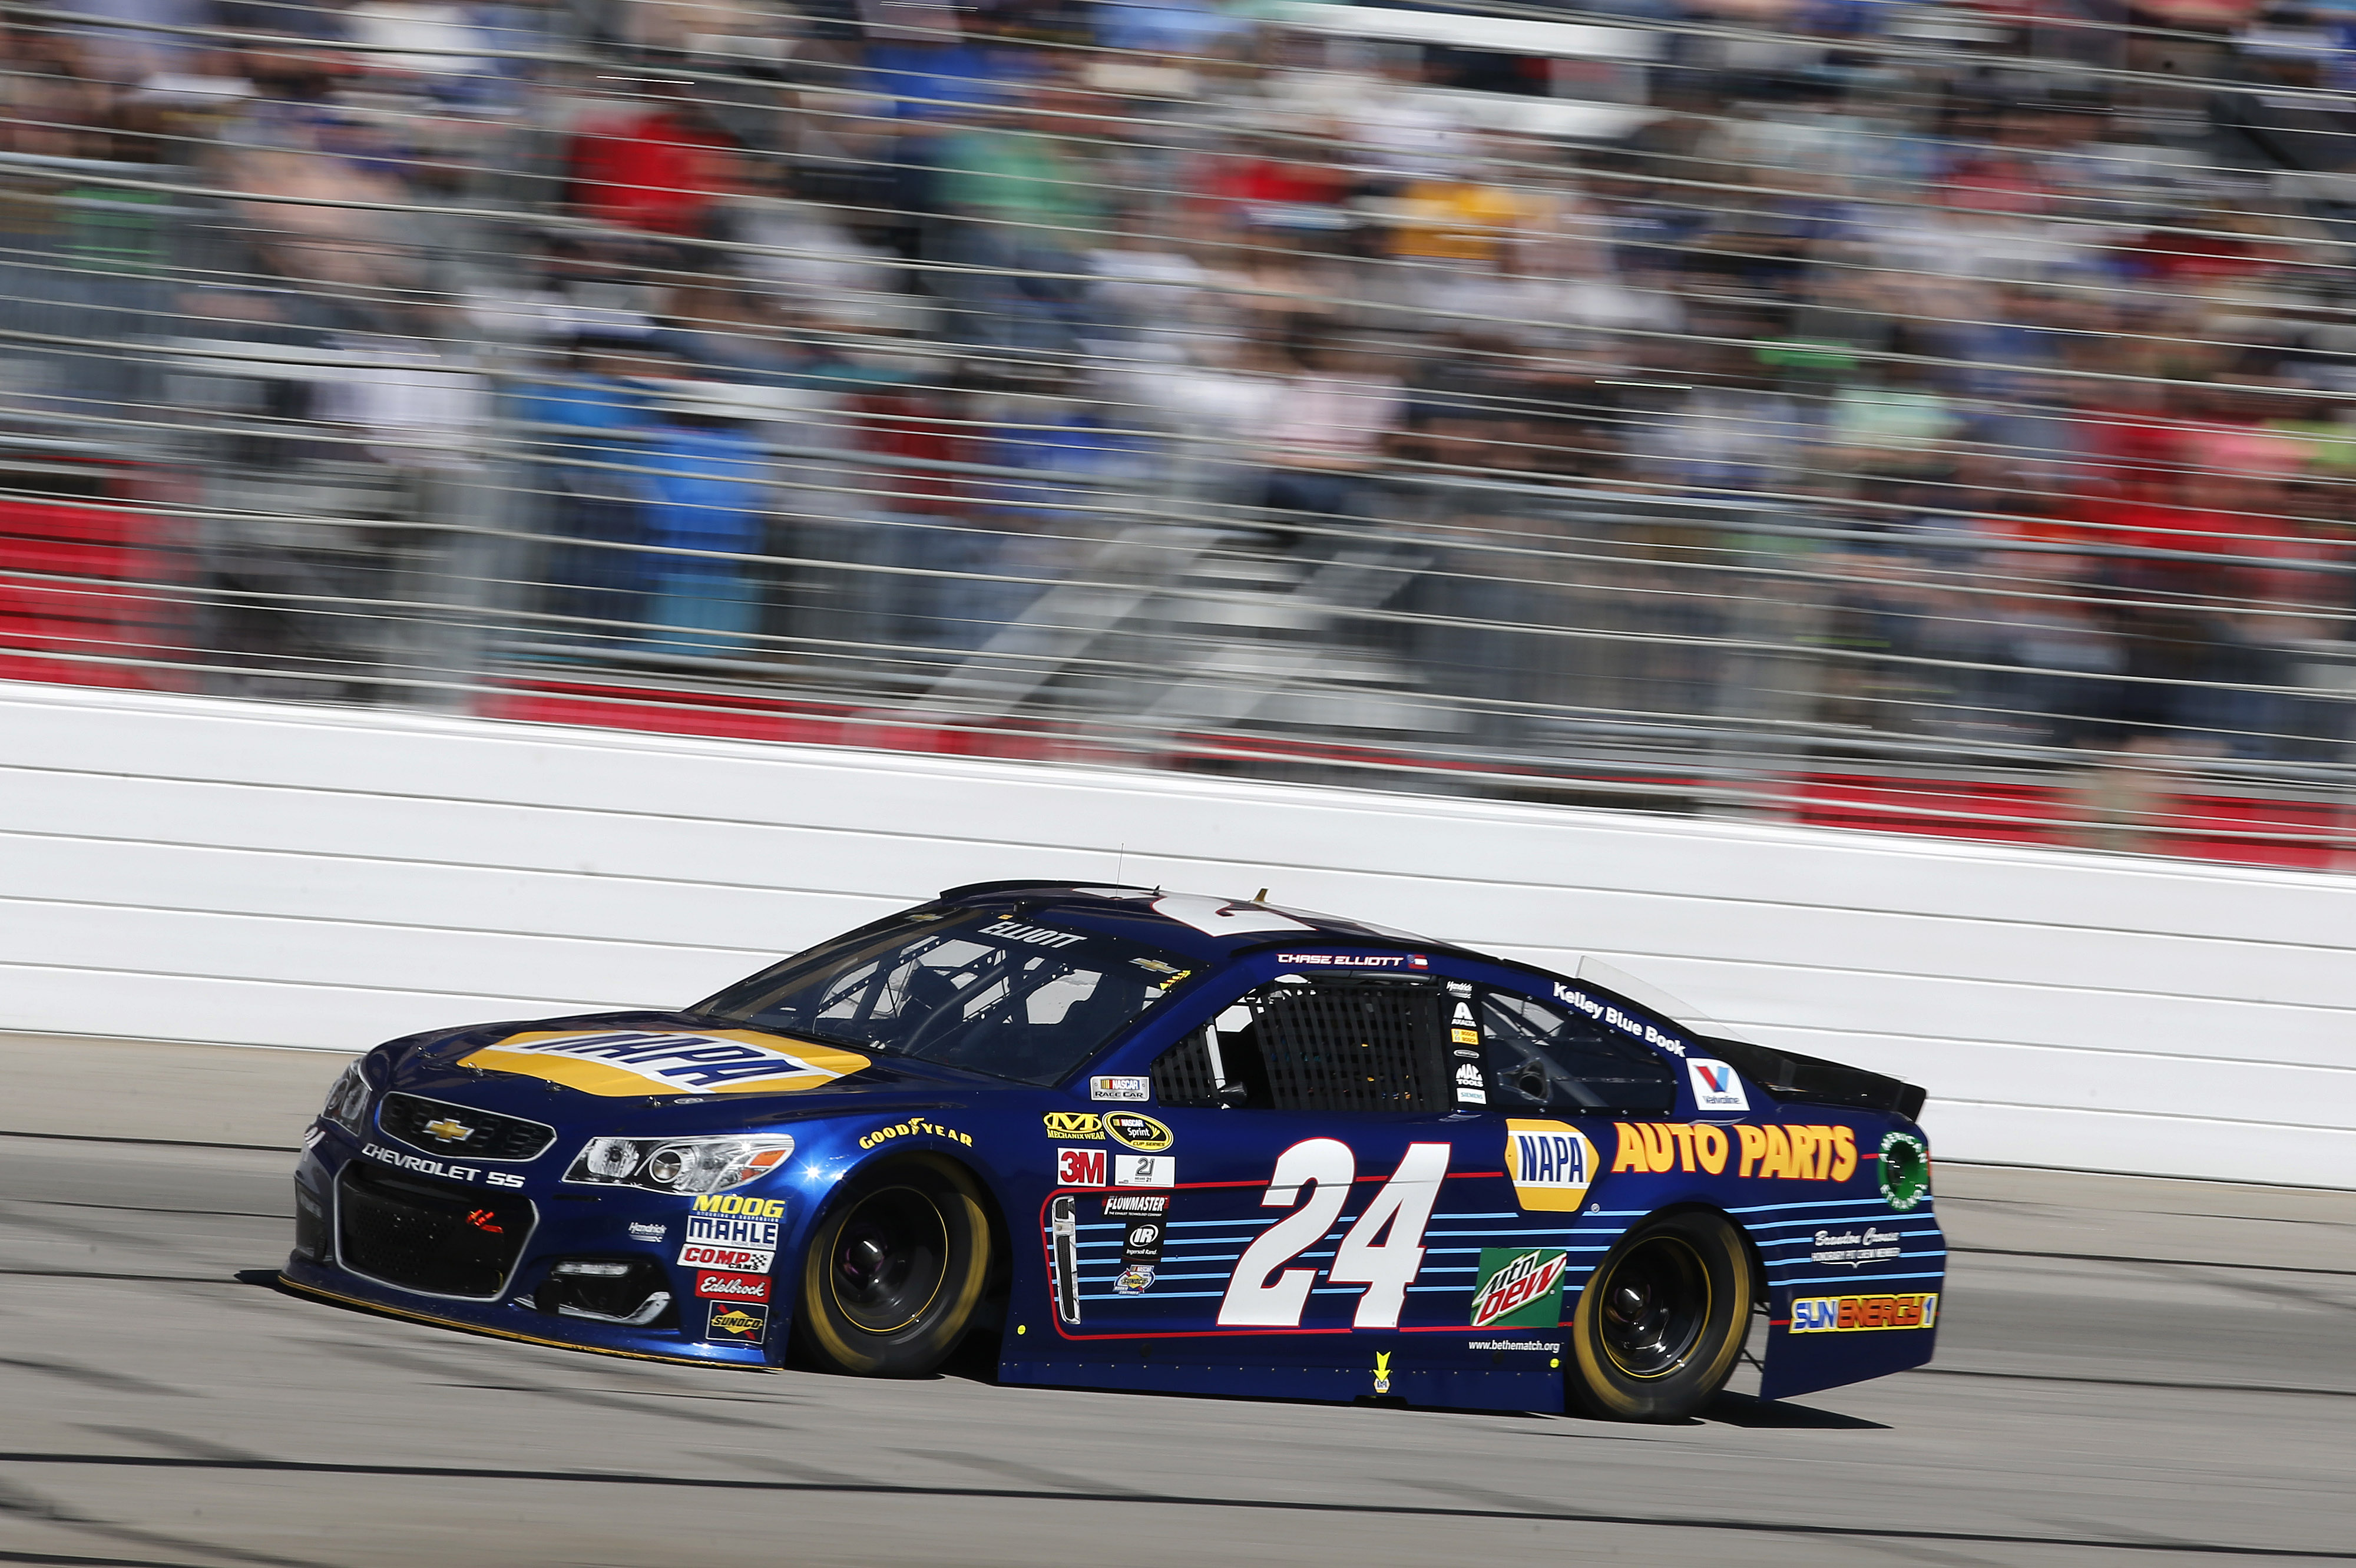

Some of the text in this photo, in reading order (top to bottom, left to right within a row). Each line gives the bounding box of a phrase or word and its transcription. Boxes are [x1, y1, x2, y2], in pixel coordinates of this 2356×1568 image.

[977, 921, 1087, 948] ELLIOTT
[1276, 954, 1404, 967] CHASE ELLIOTT
[1553, 981, 1686, 1057] Kelley Blue Book
[519, 1034, 809, 1087] NAPA
[1455, 1063, 1483, 1081] MAC
[1112, 1080, 1139, 1090] NASCAR
[1455, 1079, 1484, 1087] TOOLS
[1702, 1096, 1742, 1104] Valvoline
[1121, 1119, 1145, 1127] NASCAR
[1047, 1129, 1106, 1140] MECHANIX WEAR
[1127, 1127, 1150, 1138] Sprint
[1519, 1136, 1584, 1183] NAPA
[1612, 1122, 1858, 1183] AUTO PARTS
[362, 1143, 526, 1189] CHEVROLET SS
[1060, 1151, 1105, 1184] 3M
[1135, 1157, 1156, 1177] 21
[691, 1195, 786, 1218] MOOG
[1104, 1197, 1165, 1215] FLOWMASTER
[628, 1222, 667, 1235] Hendrick
[689, 1218, 776, 1245] MAHLE
[1134, 1228, 1154, 1243] IR
[1216, 1137, 1451, 1328] 24
[684, 1248, 751, 1265] COMP
[700, 1276, 766, 1296] Edelbrock
[713, 1316, 761, 1329] SUNOCO
[1468, 1340, 1560, 1354] www.bethematch.org
